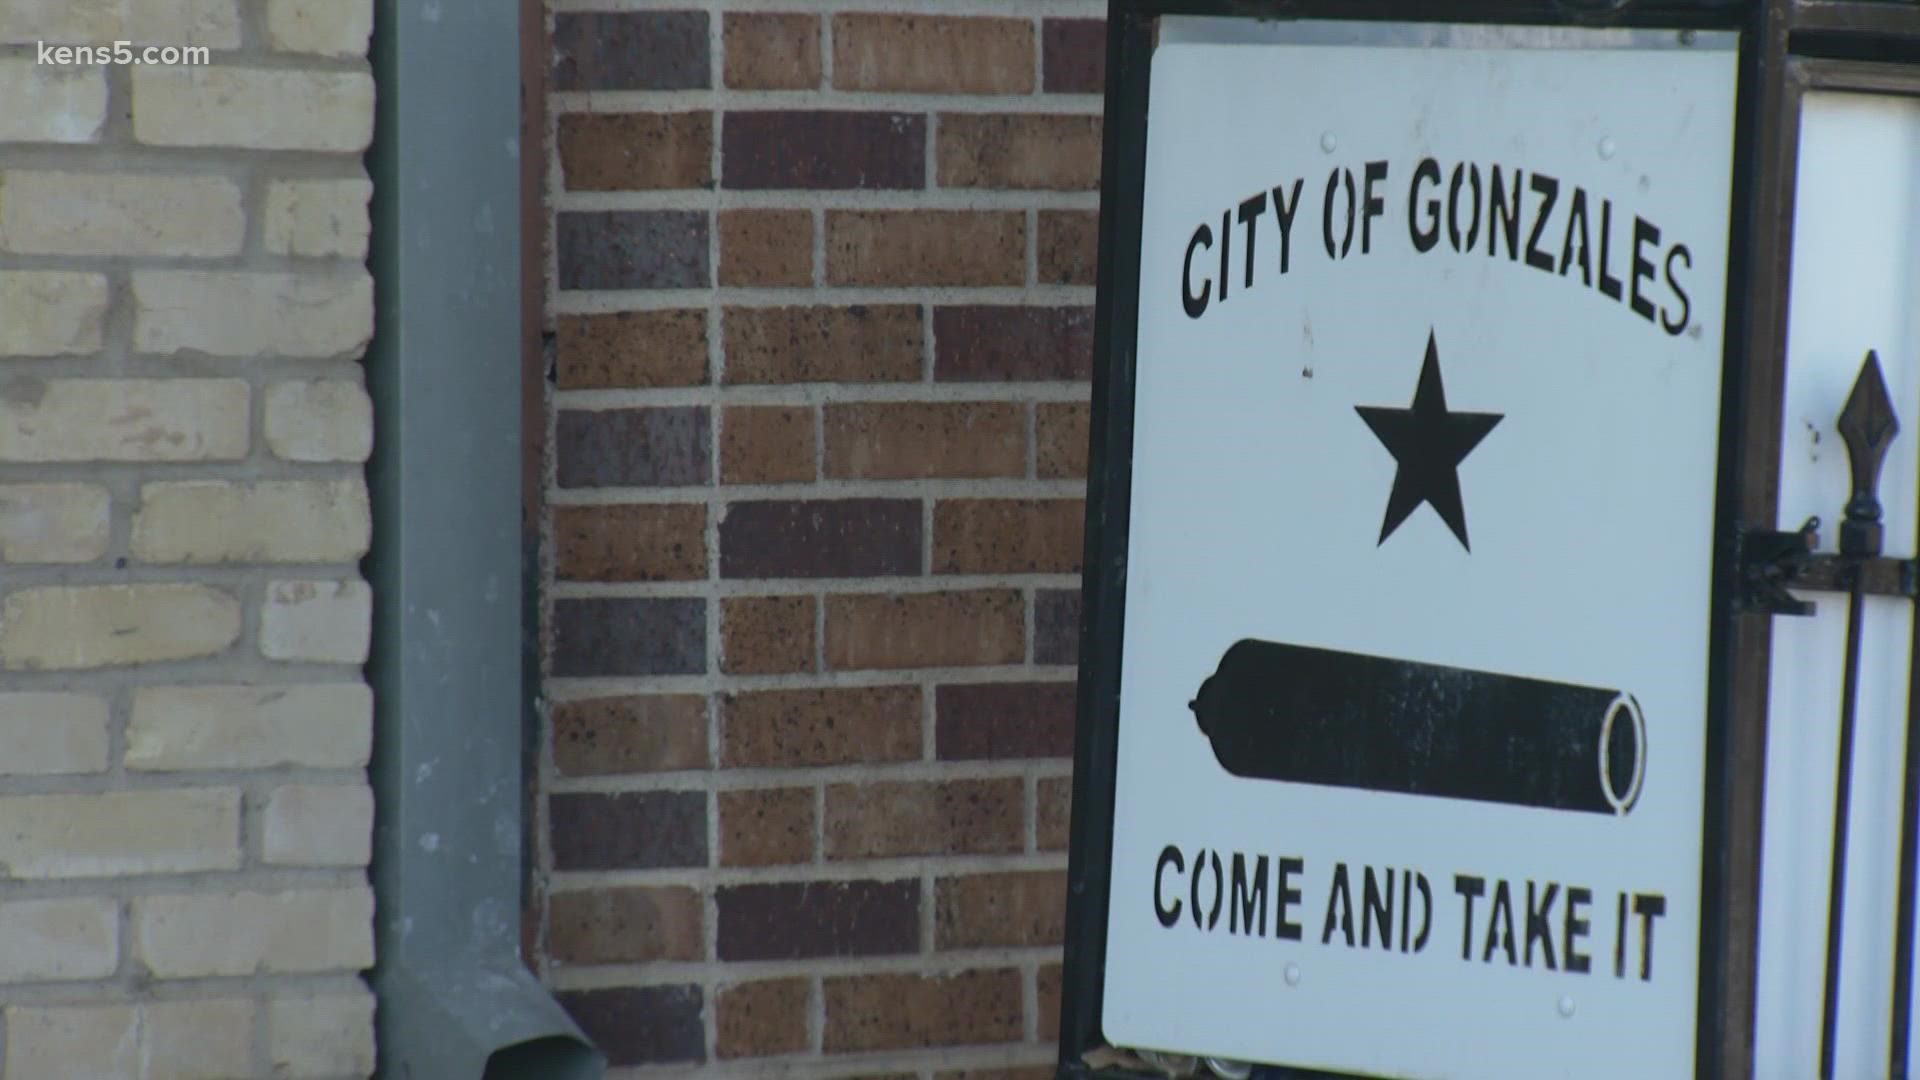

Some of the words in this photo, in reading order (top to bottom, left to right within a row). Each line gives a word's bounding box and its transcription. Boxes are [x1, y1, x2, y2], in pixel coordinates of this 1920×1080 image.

[1181, 178, 1305, 320] CITY
[1322, 160, 1389, 260] OF
[1408, 157, 1692, 336] GONZALES
[1153, 844, 1304, 942] COME
[1321, 862, 1433, 953] AND
[1454, 874, 1592, 974] TAKE
[1615, 892, 1666, 981] IT
